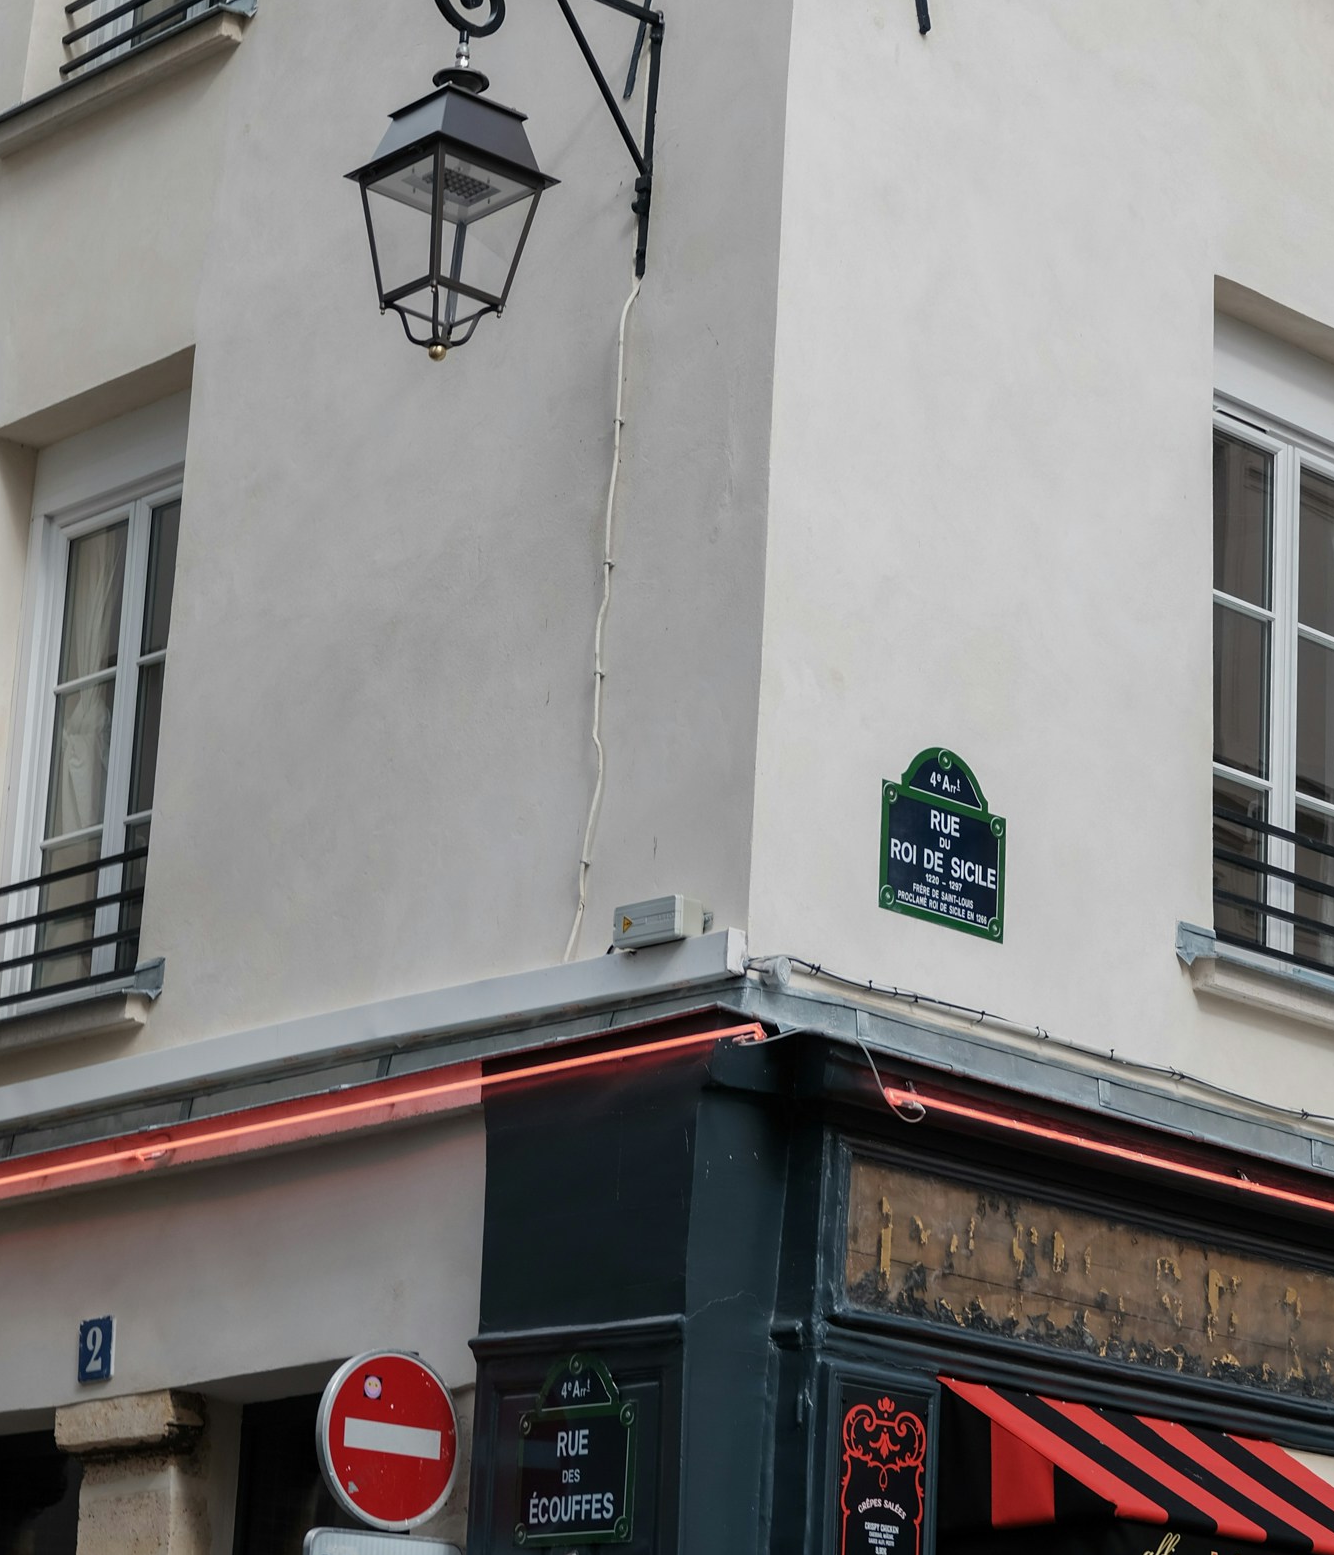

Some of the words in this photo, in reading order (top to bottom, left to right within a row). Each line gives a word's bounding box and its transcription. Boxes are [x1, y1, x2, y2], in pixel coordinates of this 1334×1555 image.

[930, 809, 960, 837] RUE
[939, 837, 951, 850] DU
[890, 838, 916, 865] ROI
[923, 849, 943, 873] DE
[951, 857, 996, 889] SICILE
[912, 882, 930, 897] FRÈRE
[931, 888, 939, 898] DE
[940, 890, 974, 909] SAINT-LOUIS
[925, 873, 940, 885] 1220
[949, 880, 963, 892] 1297
[897, 889, 927, 907] PROCLAMÉ
[928, 899, 939, 910] ROI
[940, 902, 947, 913] DE
[949, 904, 966, 918] SICILE
[967, 910, 975, 920] EN
[976, 912, 988, 925] 1266
[85, 1326, 103, 1373] 2
[556, 1429, 589, 1457] RUE
[561, 1469, 580, 1483] DES
[529, 1491, 614, 1525] ÉCOUFFES
[858, 1498, 882, 1513] CRÊPES
[883, 1500, 907, 1520] SALÉES
